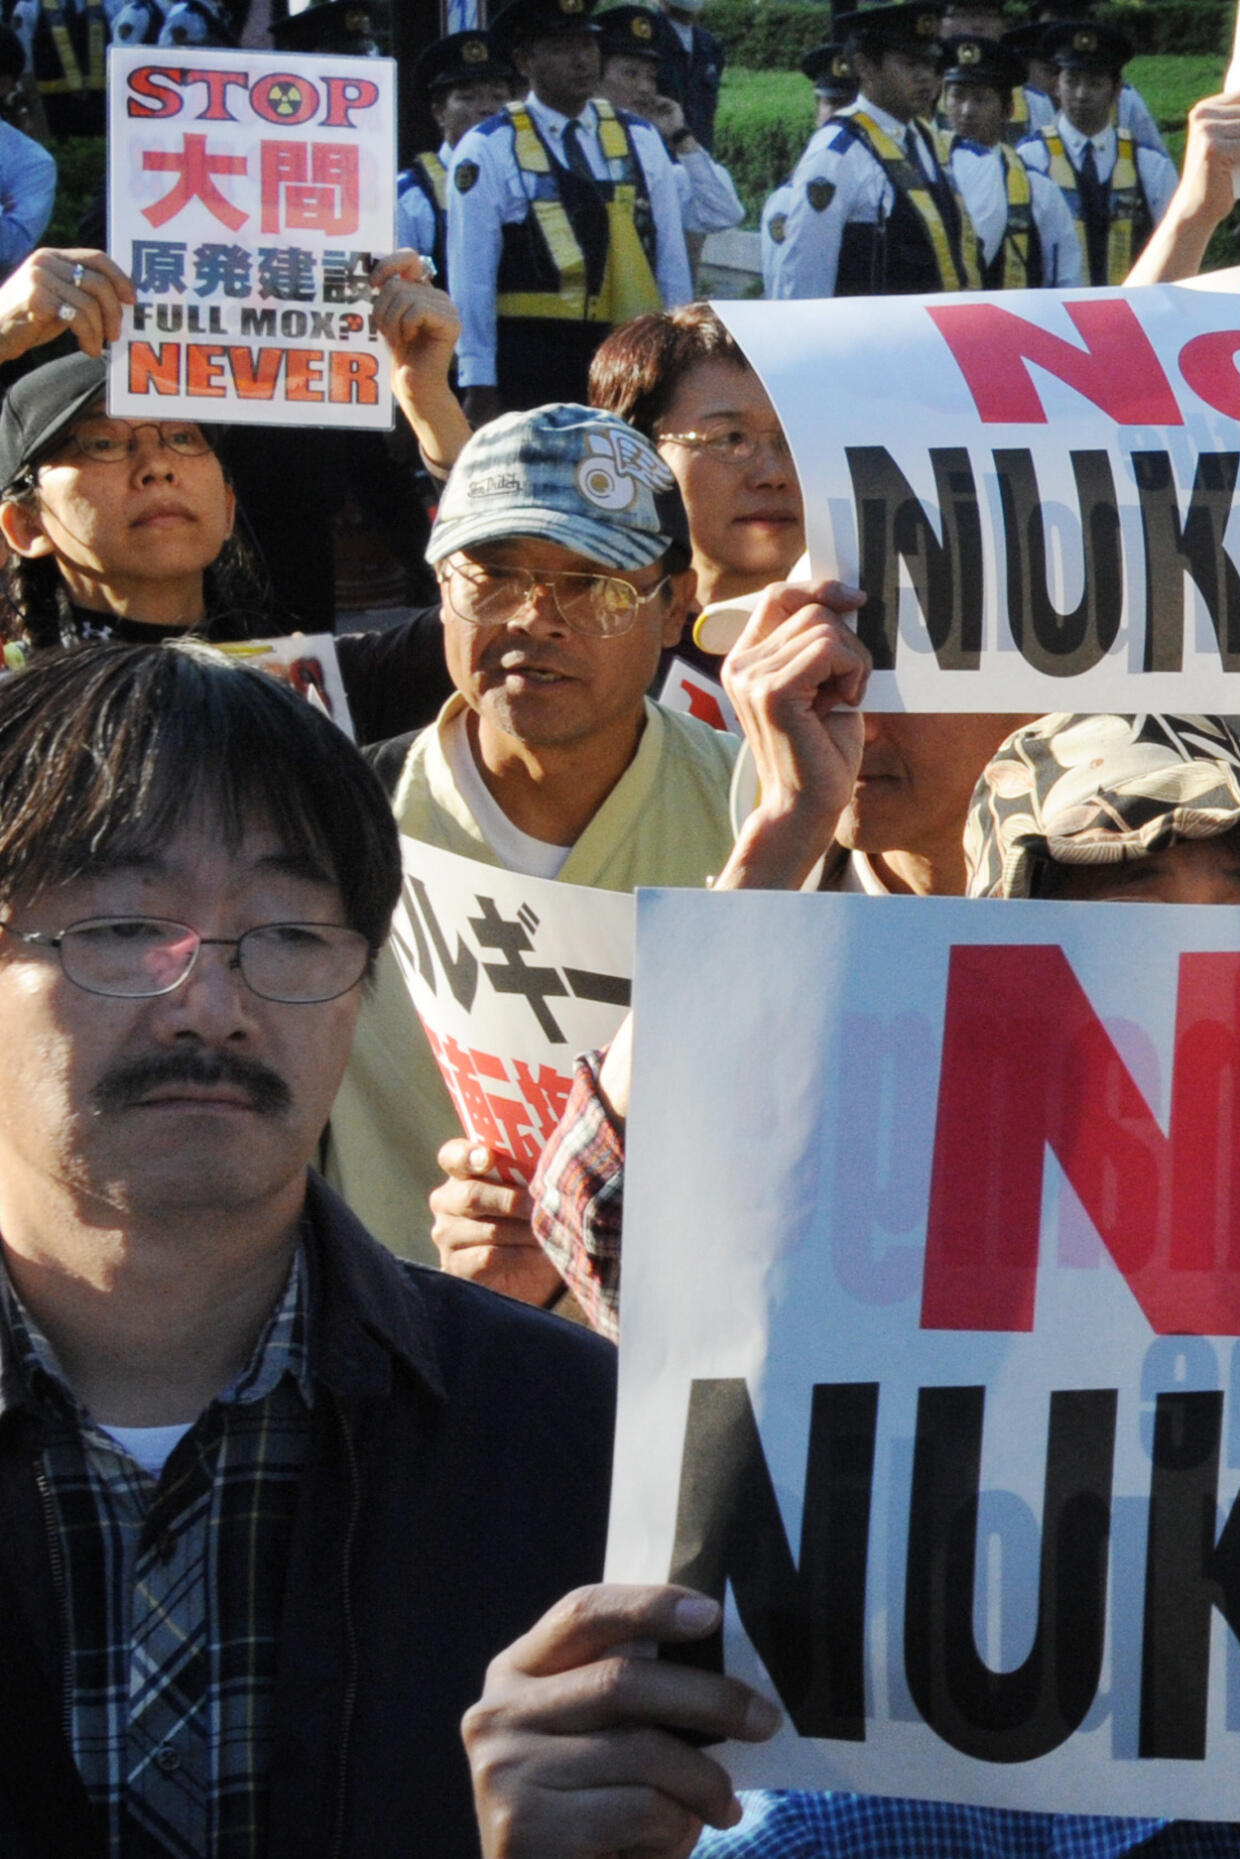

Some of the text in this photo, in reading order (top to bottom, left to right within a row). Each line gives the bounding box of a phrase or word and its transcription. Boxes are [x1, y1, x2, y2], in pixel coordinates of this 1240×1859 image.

[127, 66, 379, 128] STOP
[141, 132, 360, 236] 大間
[131, 240, 381, 304] 原発建設
[133, 304, 379, 342] FULL MOX?!
[128, 341, 380, 405] NEVER
[388, 874, 632, 1044] ルギー
